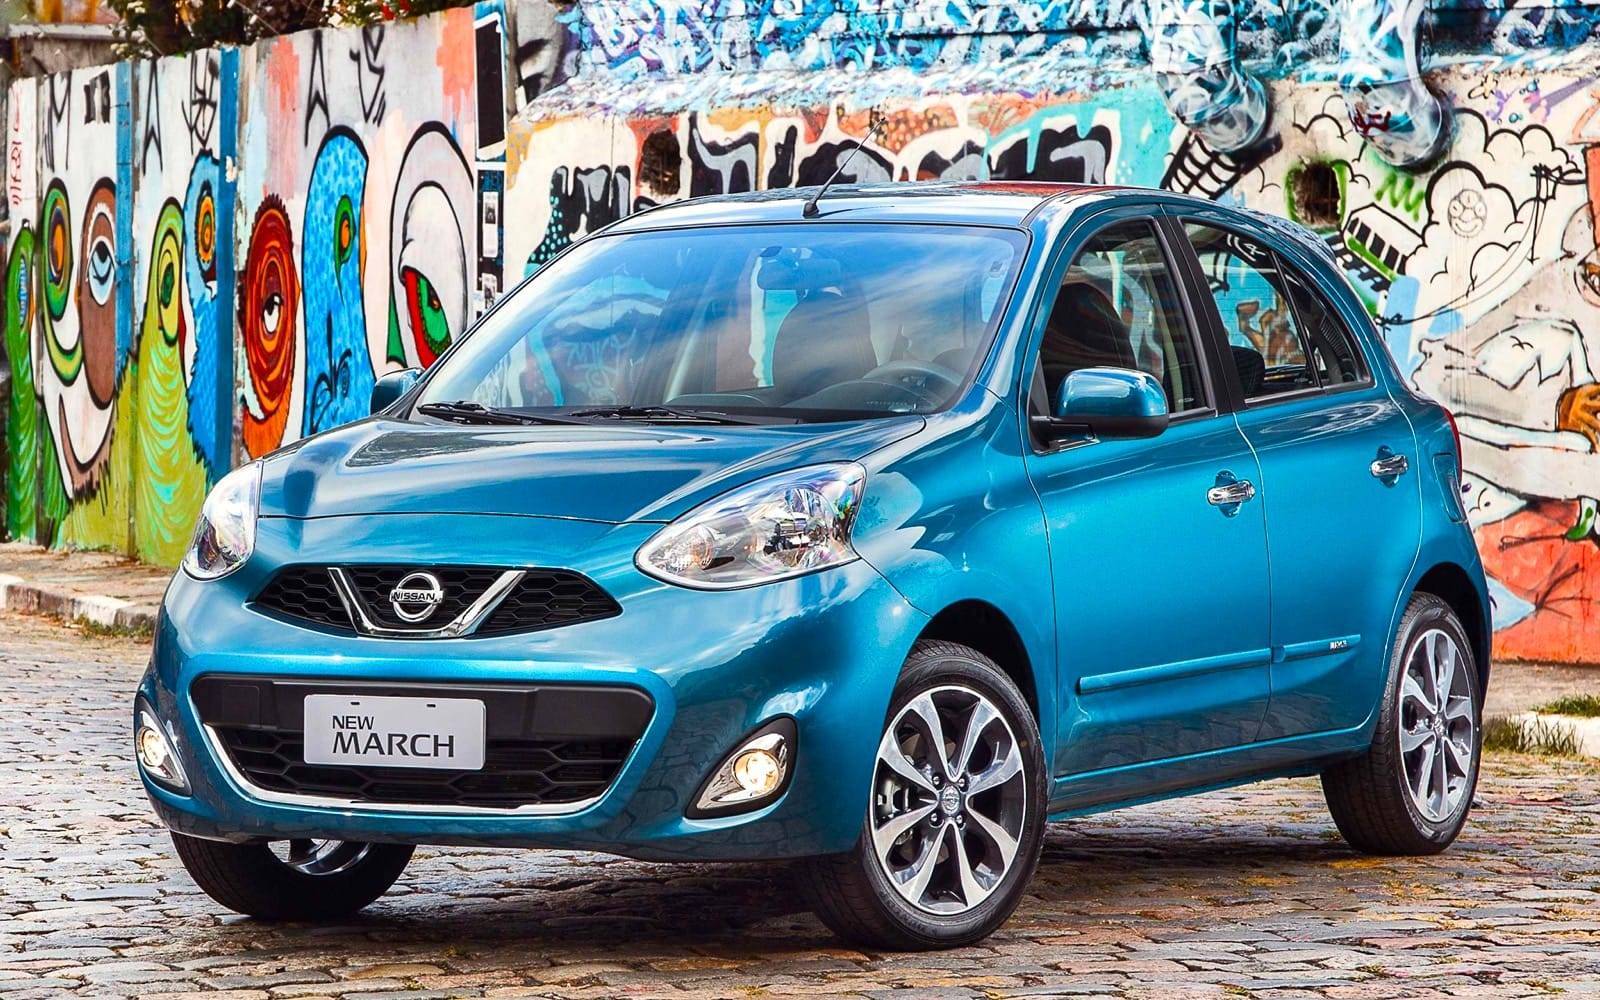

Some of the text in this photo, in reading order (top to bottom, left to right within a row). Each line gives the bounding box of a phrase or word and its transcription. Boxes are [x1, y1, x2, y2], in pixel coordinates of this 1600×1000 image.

[392, 590, 436, 602] NISSAN
[332, 715, 375, 730] NEW
[332, 731, 454, 758] MARCH
